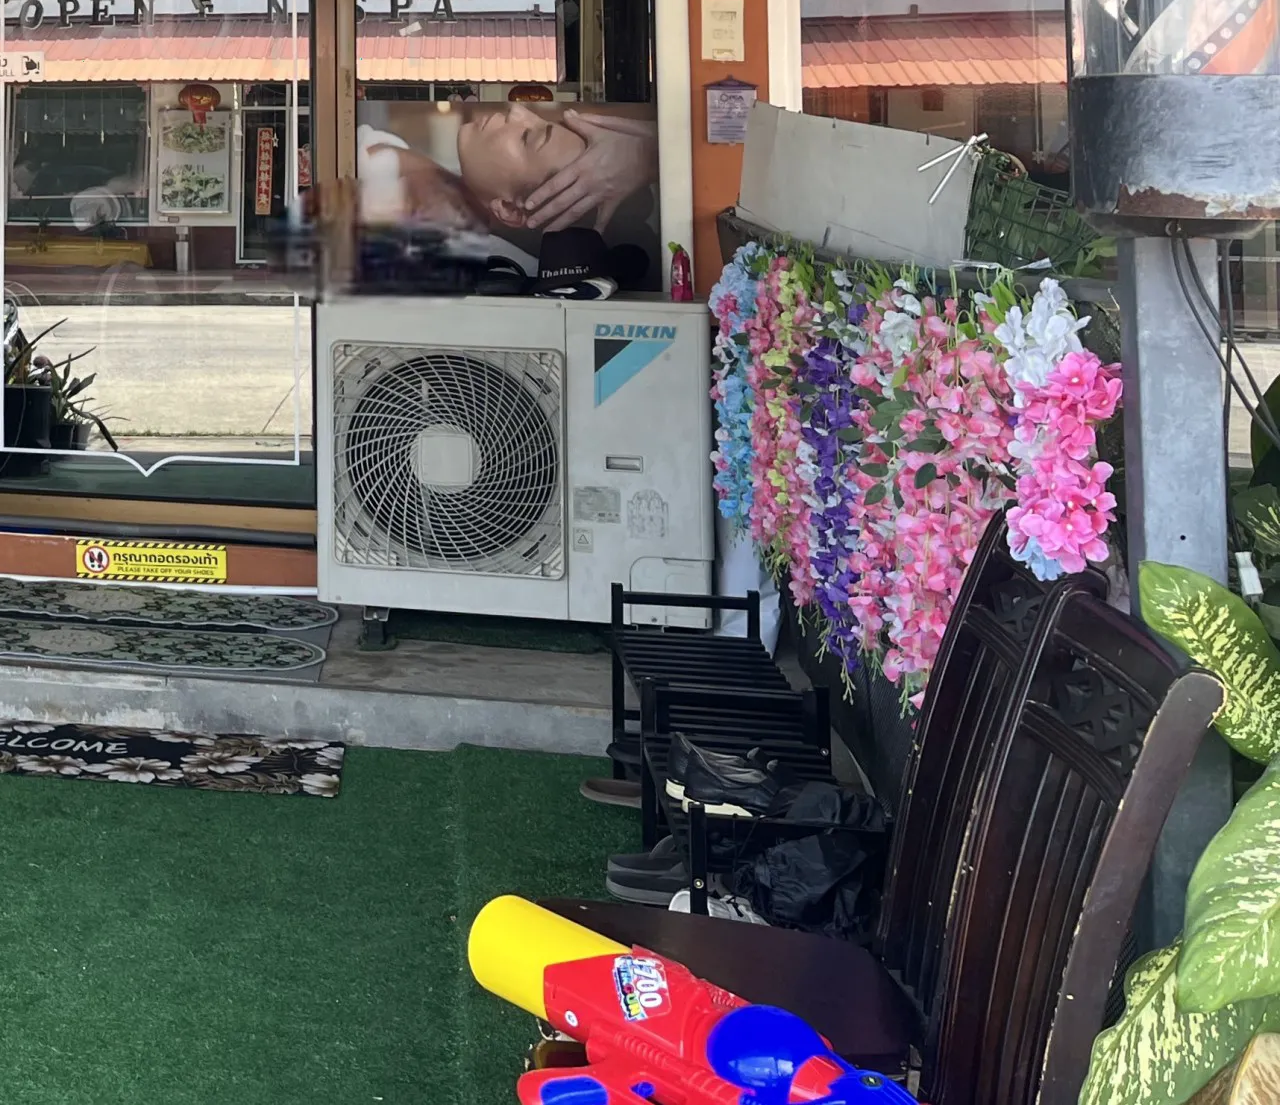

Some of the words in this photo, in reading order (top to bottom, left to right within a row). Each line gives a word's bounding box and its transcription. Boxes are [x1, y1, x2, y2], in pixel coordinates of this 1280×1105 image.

[595, 323, 677, 339] DAIKIN
[113, 552, 218, 565] กรุณาถอดรองเท้า
[117, 566, 141, 574] PLEASE
